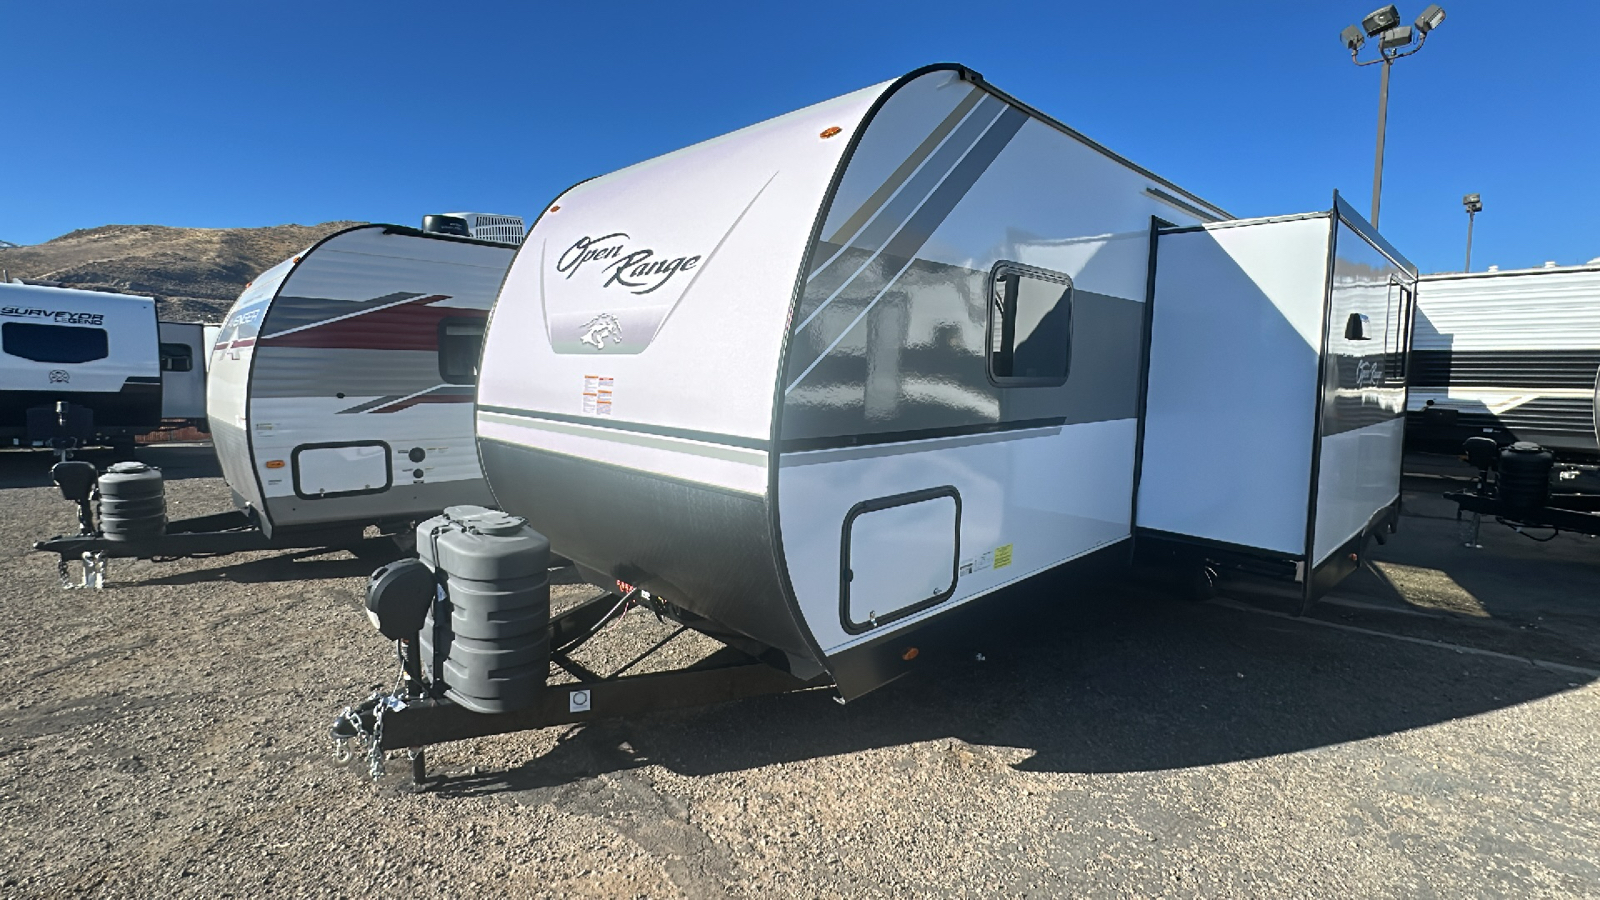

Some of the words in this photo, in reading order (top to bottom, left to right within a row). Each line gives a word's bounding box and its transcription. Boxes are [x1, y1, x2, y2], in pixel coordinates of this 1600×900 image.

[556, 232, 631, 280] Open
[601, 249, 702, 295] Range
[1, 306, 105, 321] SURVEYOR
[54, 317, 103, 326] LEGEND
[227, 308, 261, 328] ENGER
